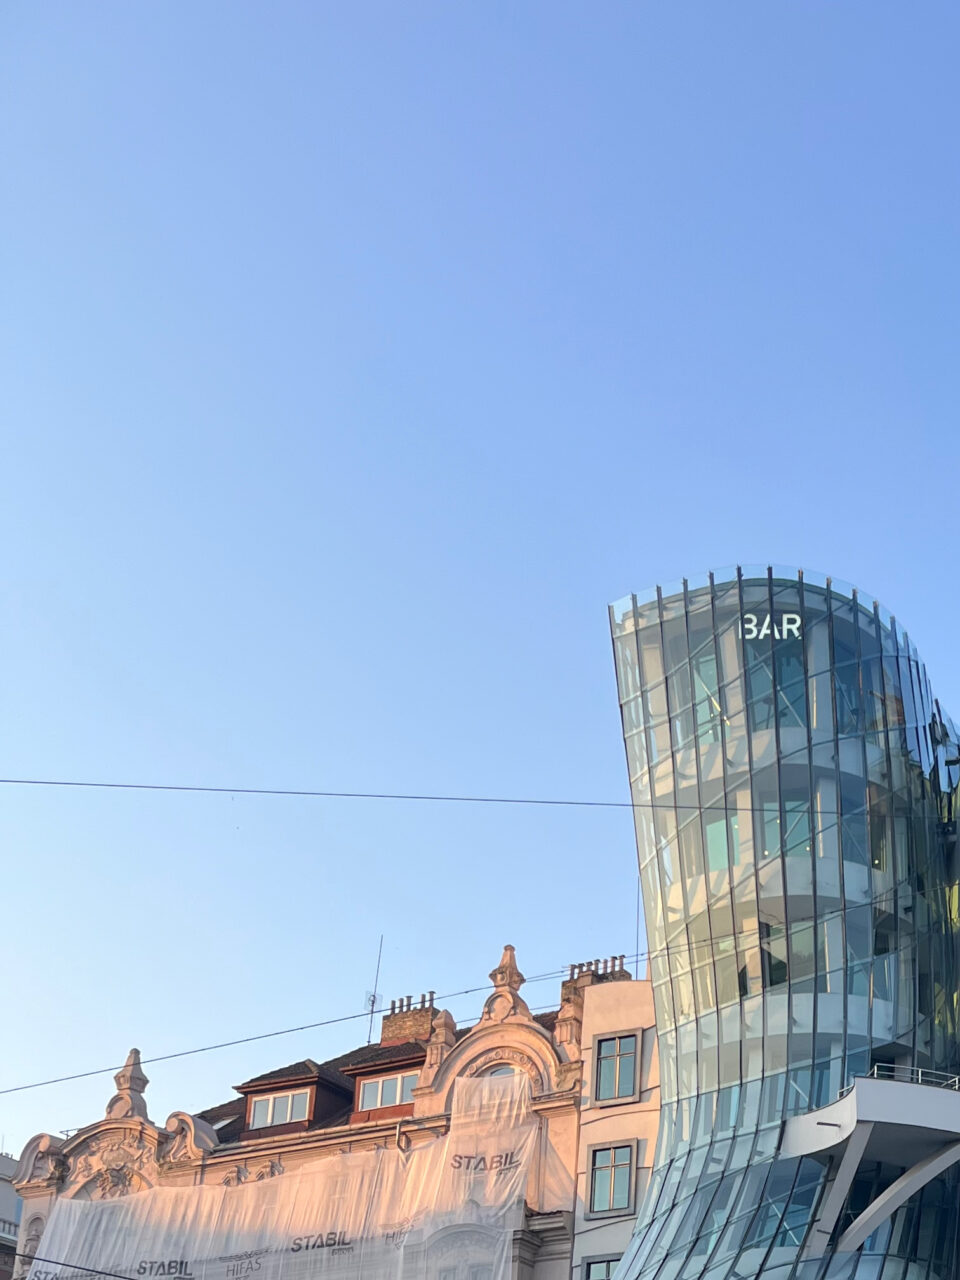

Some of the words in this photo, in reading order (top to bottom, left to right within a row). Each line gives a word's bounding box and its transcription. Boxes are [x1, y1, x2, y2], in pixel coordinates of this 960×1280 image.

[738, 613, 802, 640] BAR
[450, 1151, 521, 1171] STABIL
[291, 1231, 352, 1252] STABIL
[137, 1260, 192, 1276] STABIL
[225, 1257, 262, 1278] HIFAS
